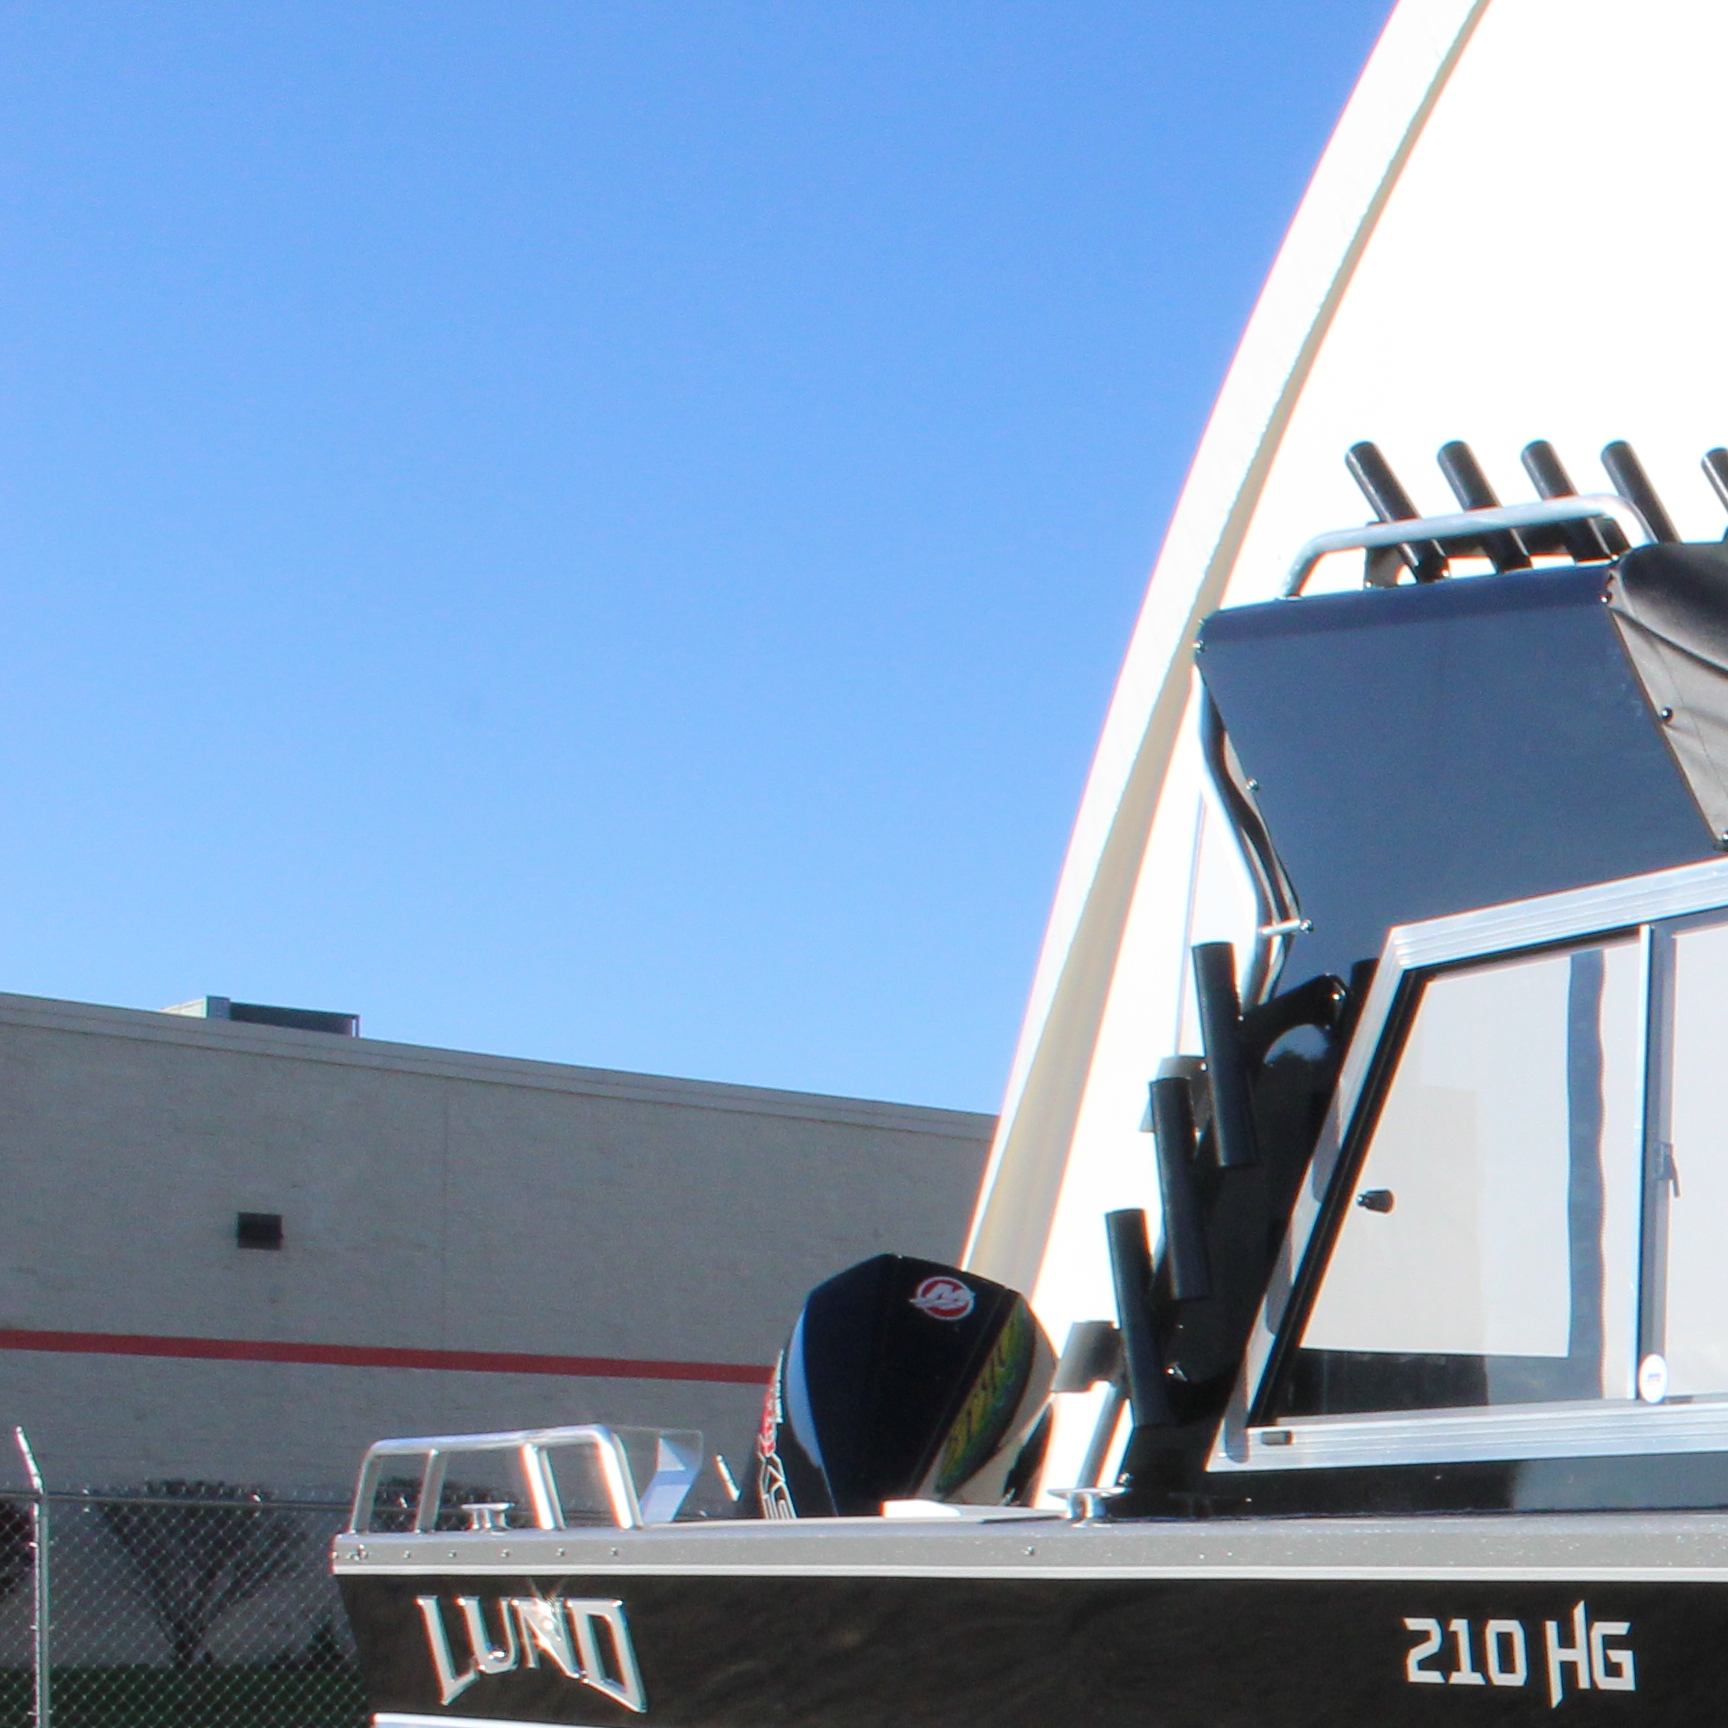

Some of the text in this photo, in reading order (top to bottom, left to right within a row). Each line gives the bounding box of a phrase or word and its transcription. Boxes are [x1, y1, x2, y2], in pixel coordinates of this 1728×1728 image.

[416, 1596, 647, 1713] LUND
[1402, 1599, 1637, 1709] 210 HG
